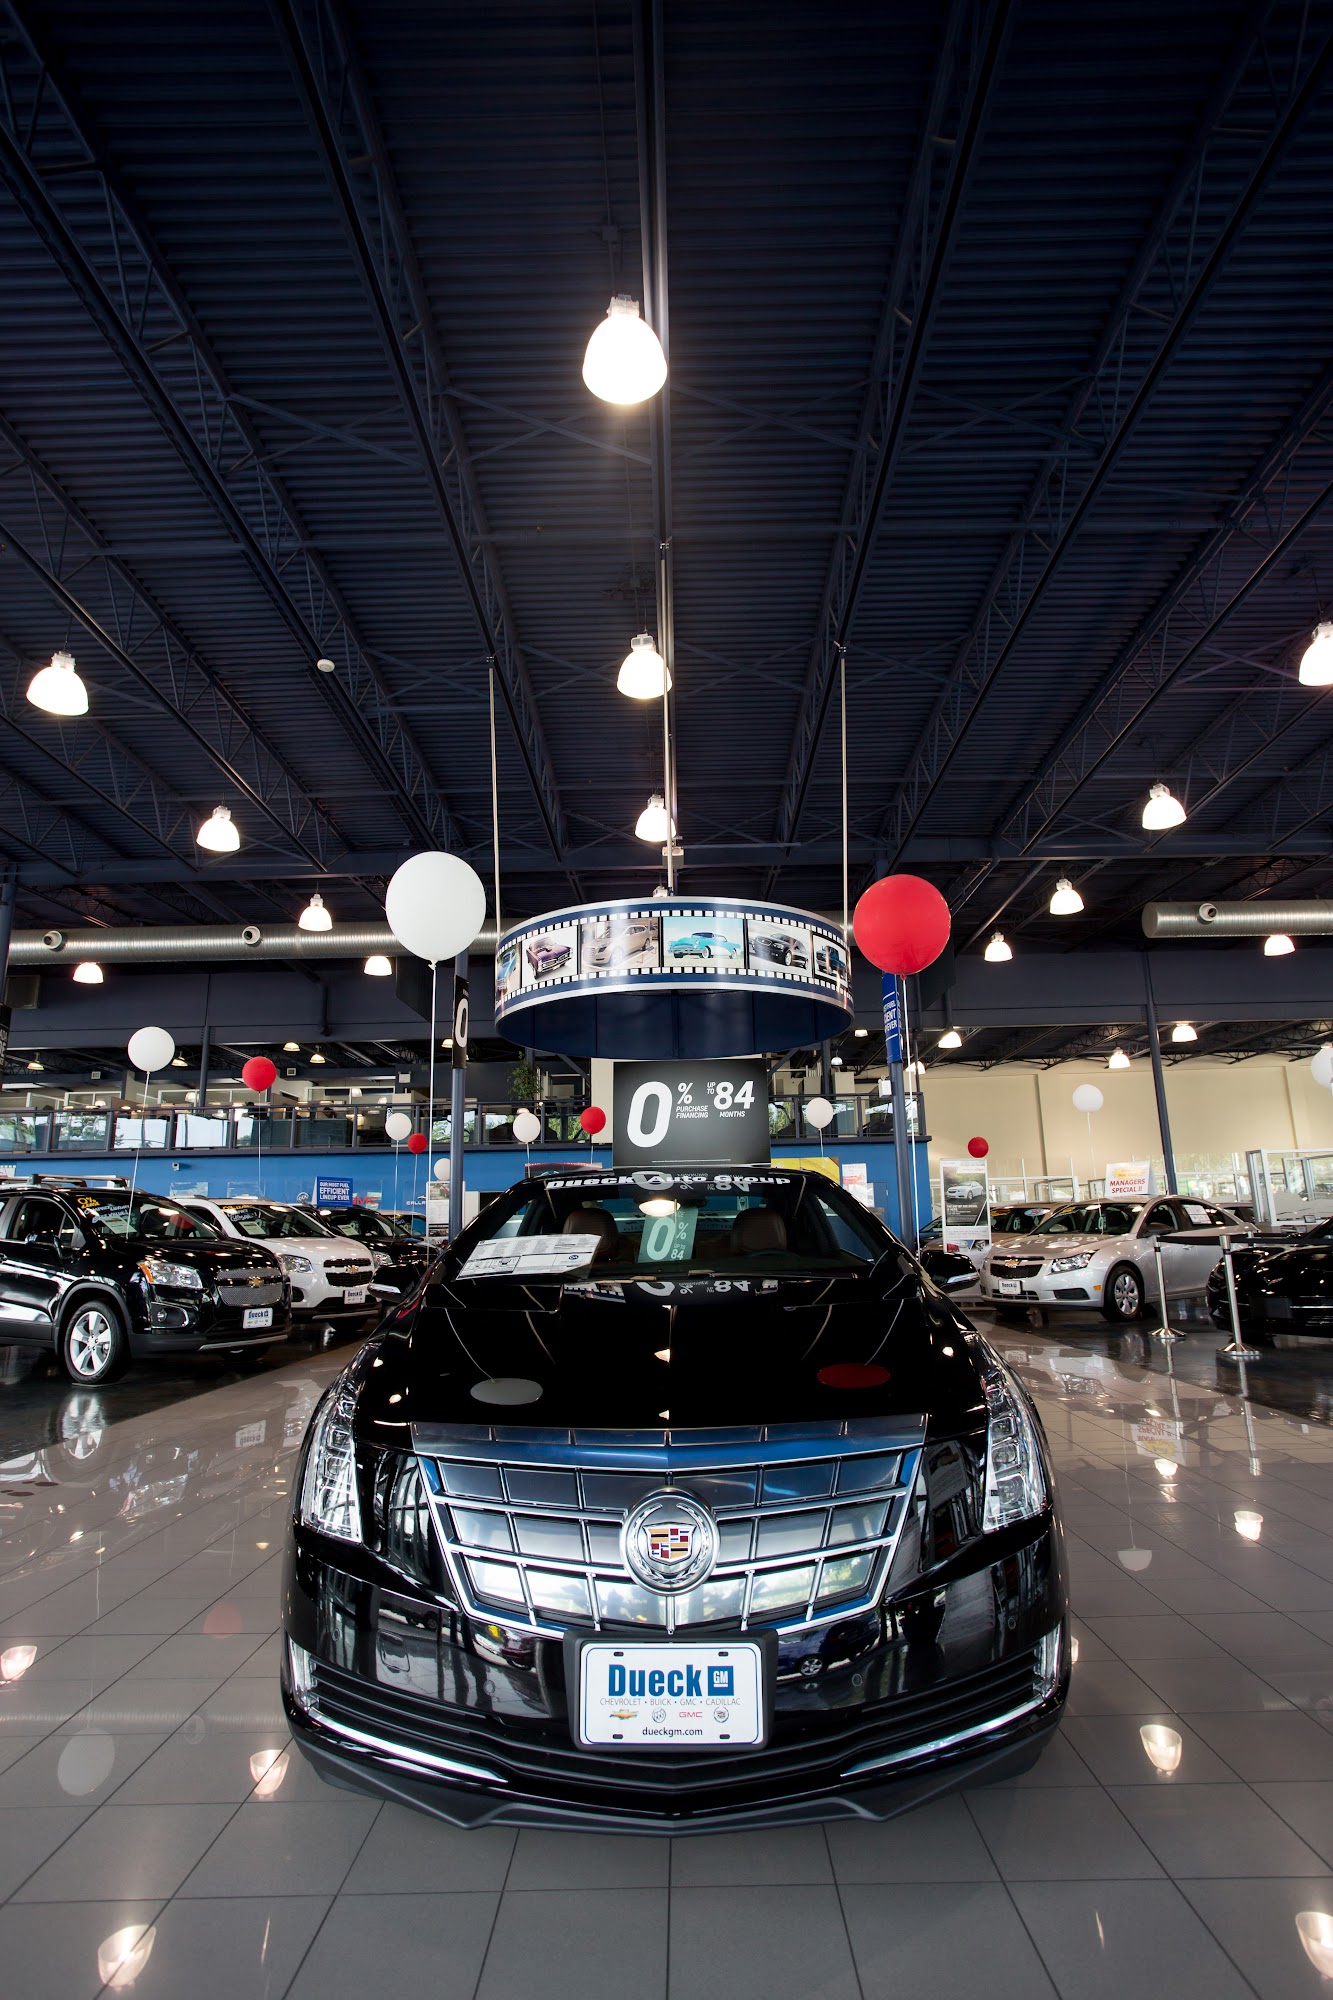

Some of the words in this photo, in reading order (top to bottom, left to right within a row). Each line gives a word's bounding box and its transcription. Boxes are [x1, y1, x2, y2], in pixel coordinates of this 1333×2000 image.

[707, 1081, 716, 1089] UP
[713, 1080, 755, 1110] 84
[546, 1176, 636, 1190] Dueck
[647, 1174, 707, 1184] Auto
[714, 1174, 791, 1185] Group
[1109, 1178, 1146, 1187] MANAGERS
[319, 1187, 350, 1195] EFFICIENT
[1111, 1186, 1137, 1194] SPECIAL
[670, 1248, 685, 1261] 84
[608, 1664, 703, 1697] Dueck
[600, 1697, 641, 1706] CHEVROLET
[650, 1697, 672, 1706] BUICK
[679, 1697, 697, 1706] GMC
[705, 1697, 741, 1706] CADILLAC
[642, 1726, 703, 1737] dueckgm.com
